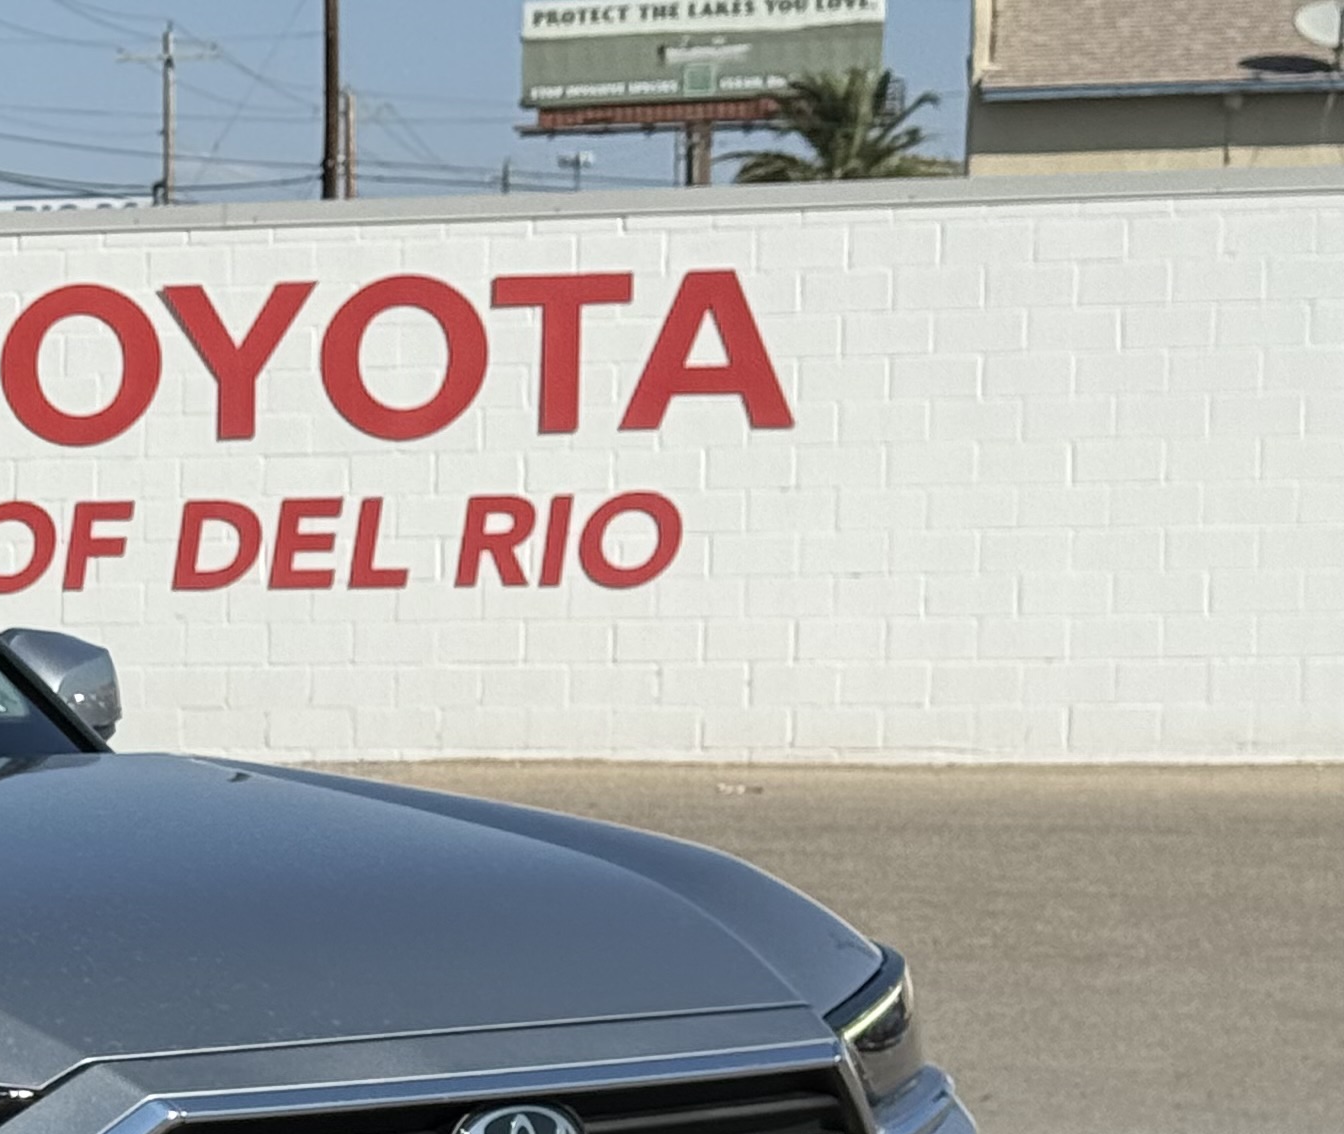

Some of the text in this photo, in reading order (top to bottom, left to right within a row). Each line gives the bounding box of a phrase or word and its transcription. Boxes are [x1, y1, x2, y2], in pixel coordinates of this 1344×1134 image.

[532, 4, 629, 28] PROTECT
[639, 2, 679, 22] THE
[687, 0, 755, 18] LAKES
[763, 0, 809, 15] YOU
[172, 497, 408, 592] DEL
[456, 491, 683, 589] RIO
